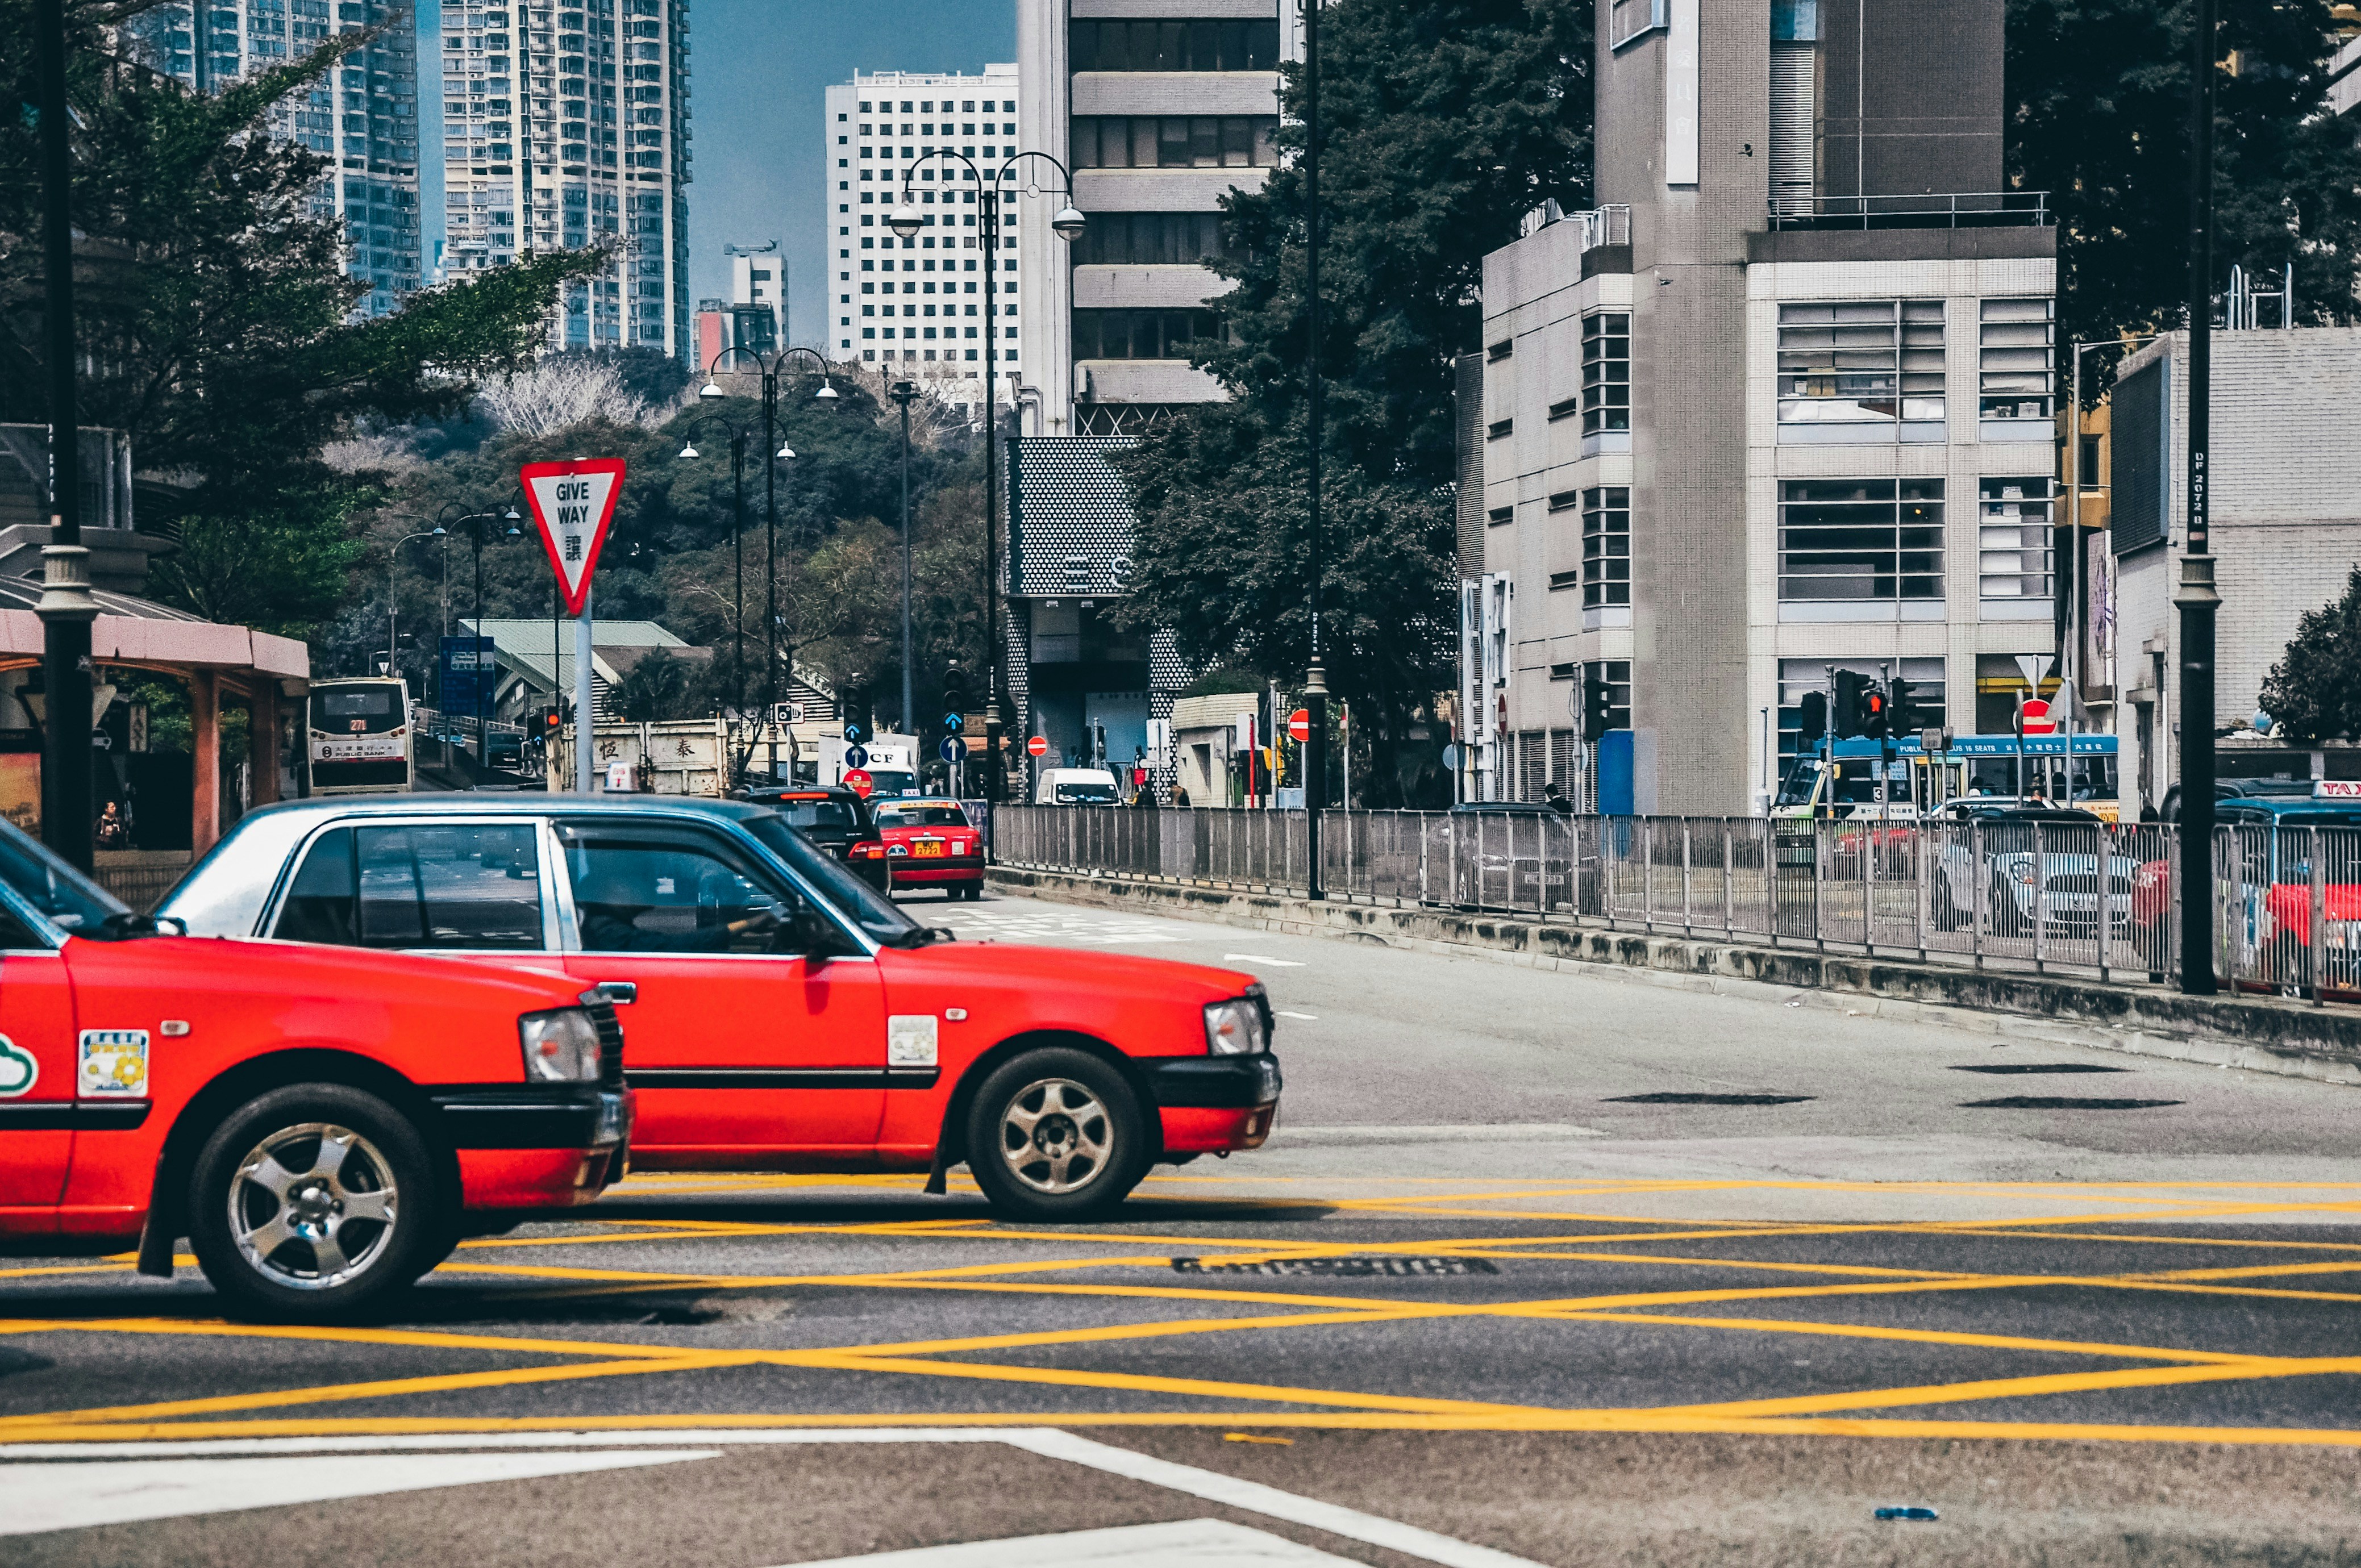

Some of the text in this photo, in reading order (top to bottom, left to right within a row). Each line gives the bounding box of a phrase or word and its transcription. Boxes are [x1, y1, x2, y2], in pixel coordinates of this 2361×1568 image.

[2195, 452, 2204, 469] DF
[557, 482, 589, 501] GIVE
[557, 506, 589, 524] WAY
[870, 753, 894, 763] CF
